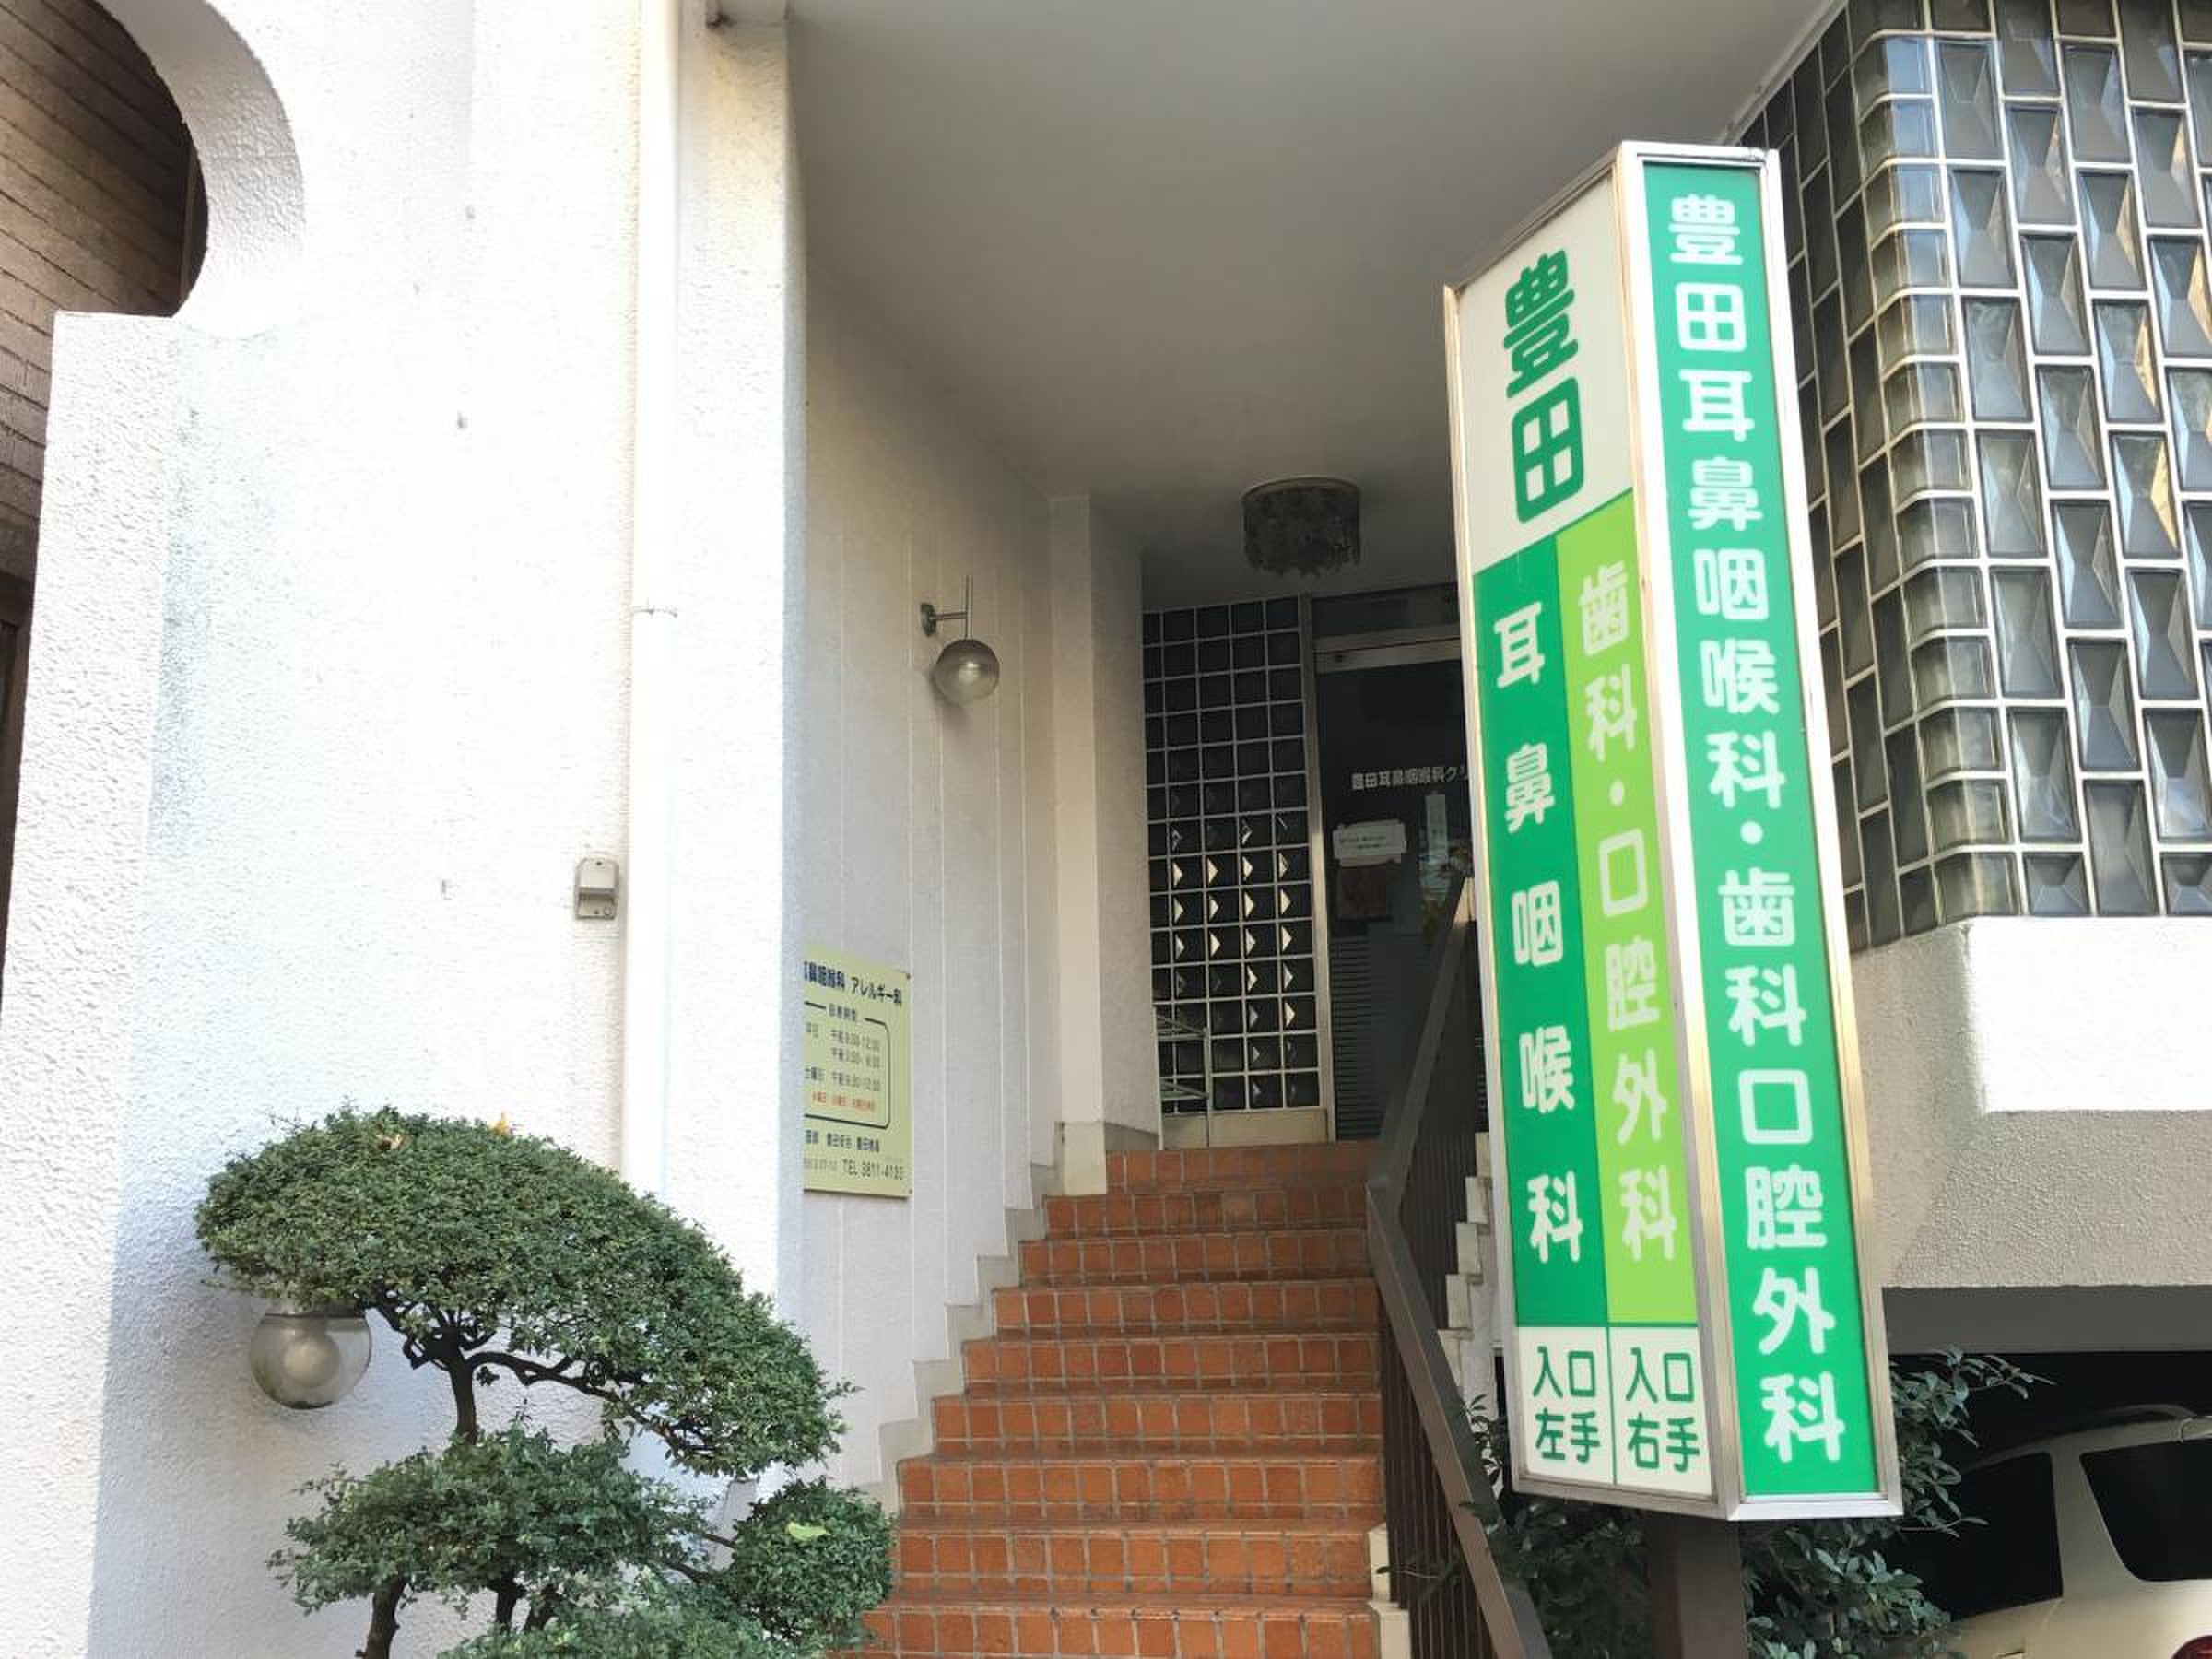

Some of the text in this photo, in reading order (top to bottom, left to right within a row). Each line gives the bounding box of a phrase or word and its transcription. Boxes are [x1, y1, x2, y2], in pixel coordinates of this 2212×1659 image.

[1503, 250, 1584, 524] 豊田
[1493, 601, 1583, 1263] 耳鼻咽喉科
[1533, 1346, 1596, 1397] 入口
[1625, 1347, 1695, 1403] 入口
[1535, 1408, 1600, 1464] 左手
[1627, 1412, 1700, 1474] 右手
